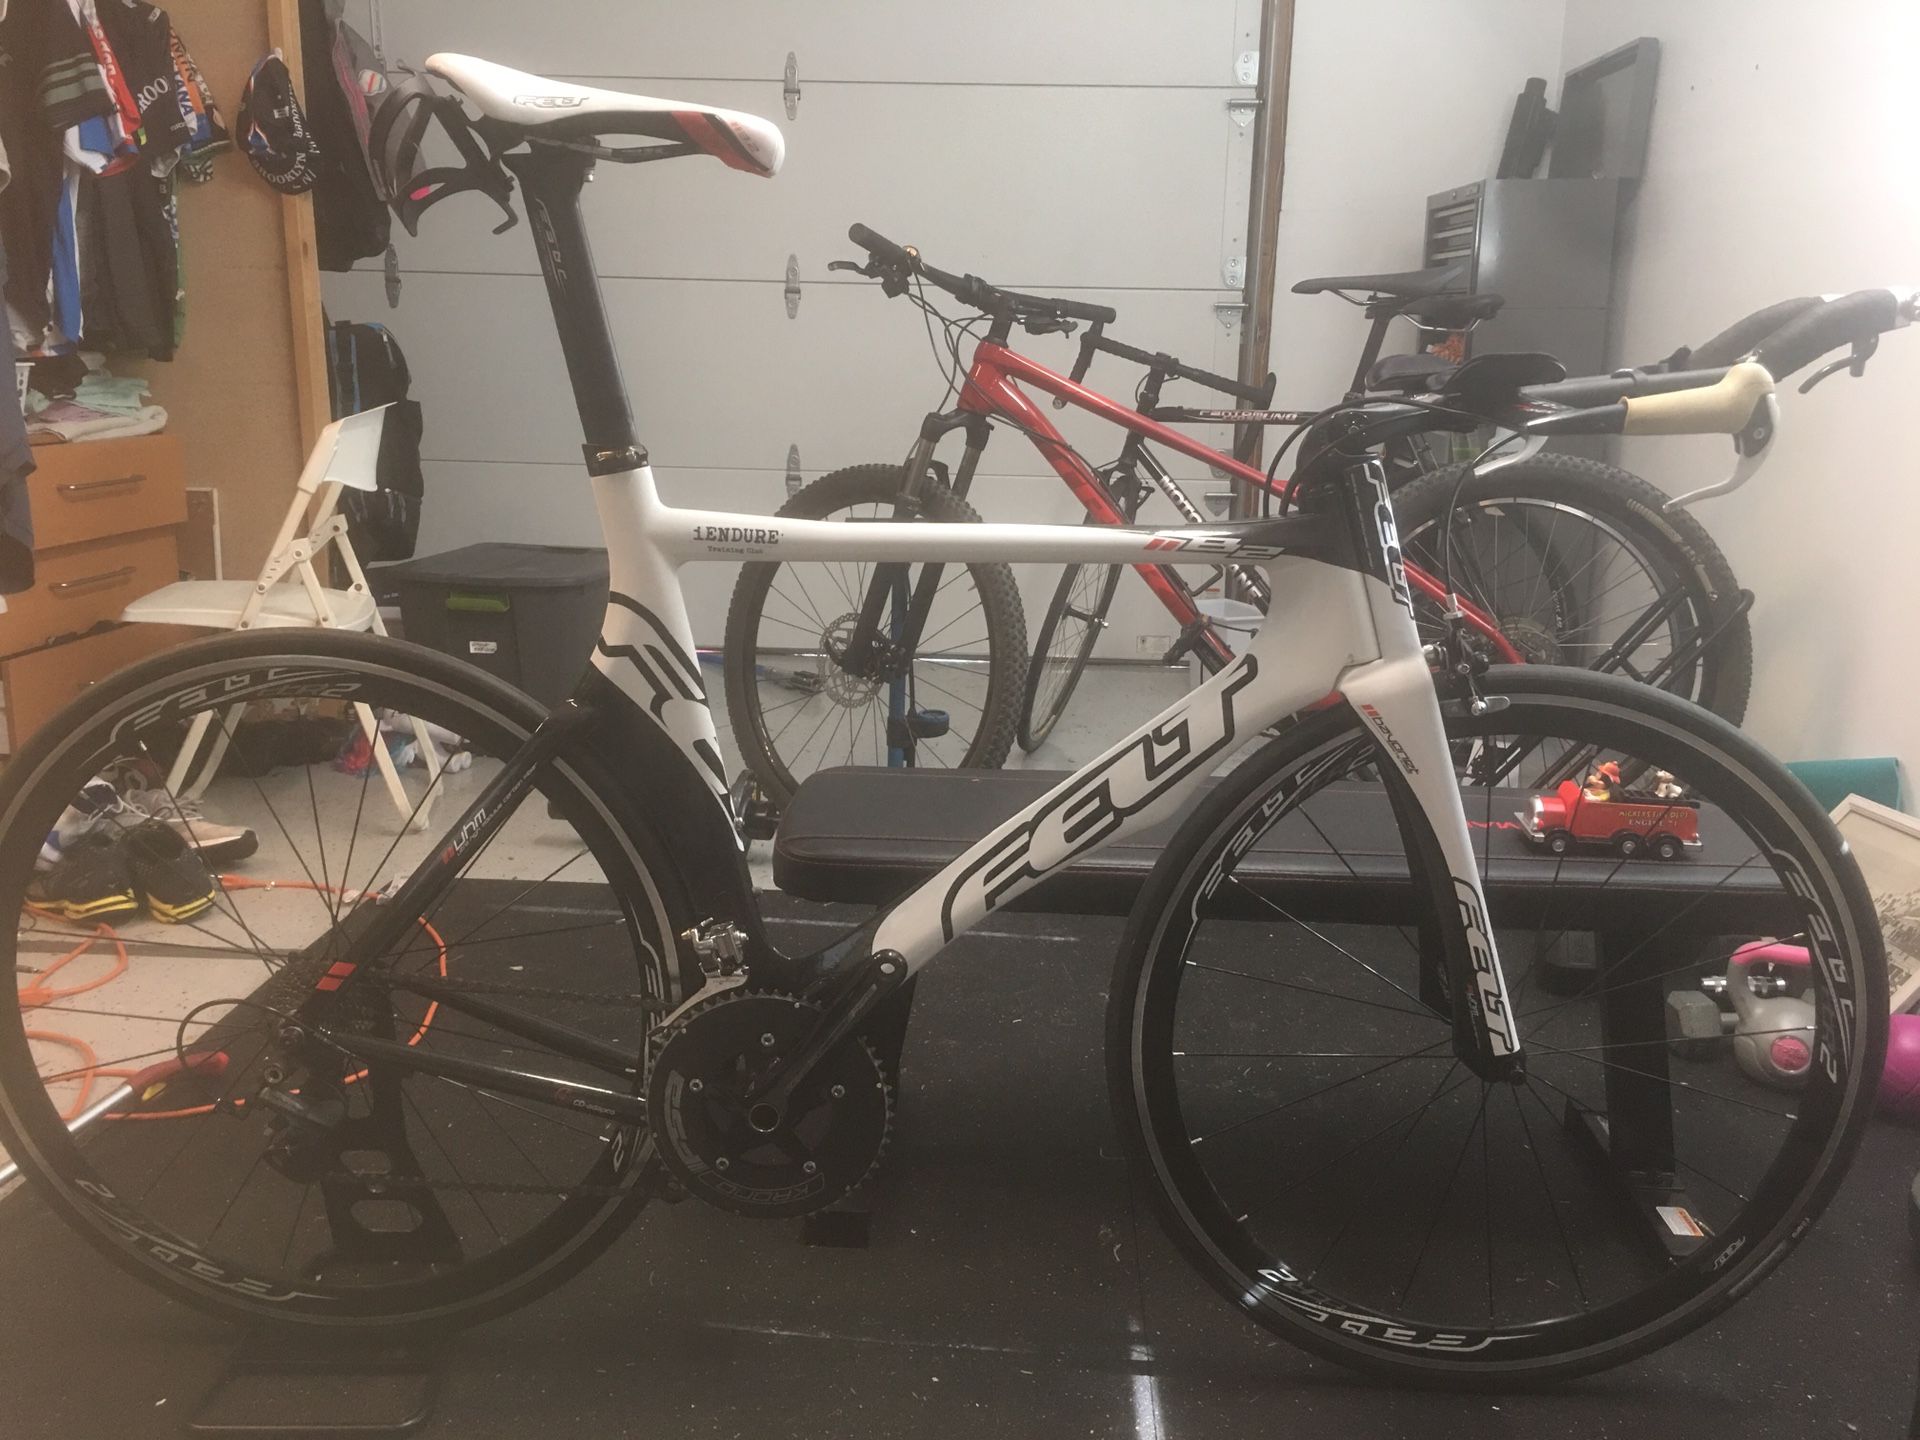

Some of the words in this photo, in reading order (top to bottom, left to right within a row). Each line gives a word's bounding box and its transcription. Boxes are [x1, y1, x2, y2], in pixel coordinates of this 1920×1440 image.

[513, 94, 590, 108] FELT
[693, 526, 779, 545] iENDURE
[1372, 716, 1420, 775] bayonet
[940, 653, 1258, 944] FELT
[1450, 876, 1515, 1053] FELT
